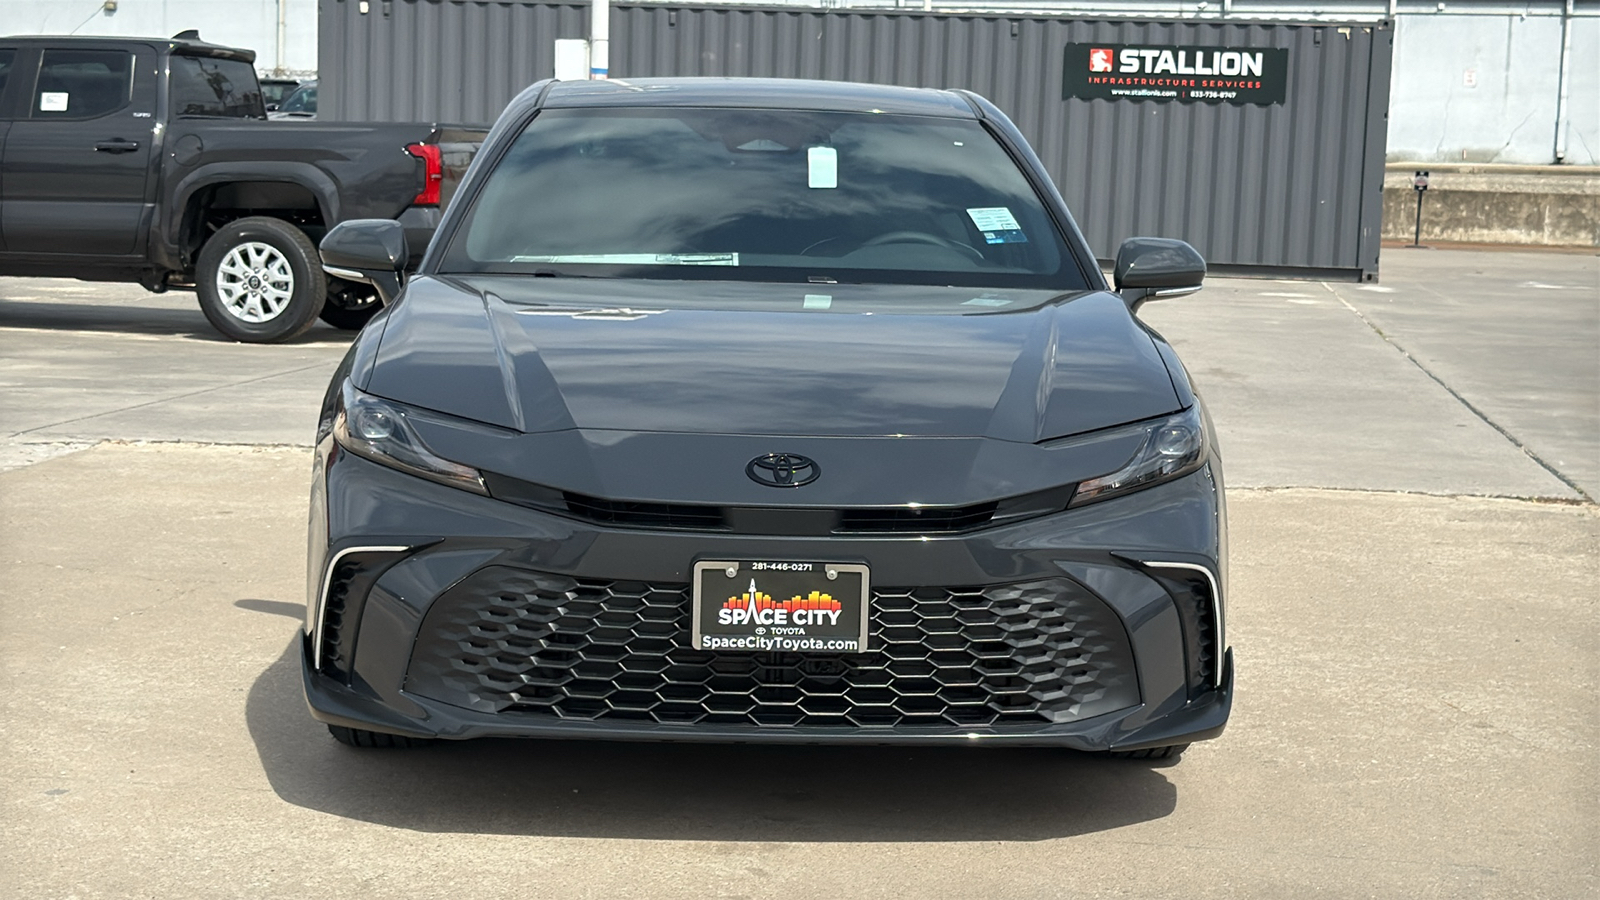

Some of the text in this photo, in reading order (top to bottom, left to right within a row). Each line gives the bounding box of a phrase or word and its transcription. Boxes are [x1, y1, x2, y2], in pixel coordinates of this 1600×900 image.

[1119, 49, 1263, 76] STALLION
[1088, 77, 1261, 89] INFRASTRUCTURE SERVICES
[752, 562, 813, 571] 281-446-0271
[718, 608, 842, 626] SPACE CITY
[770, 627, 806, 635] TOYOTA
[702, 635, 858, 651] SpaceCityToyota.com
